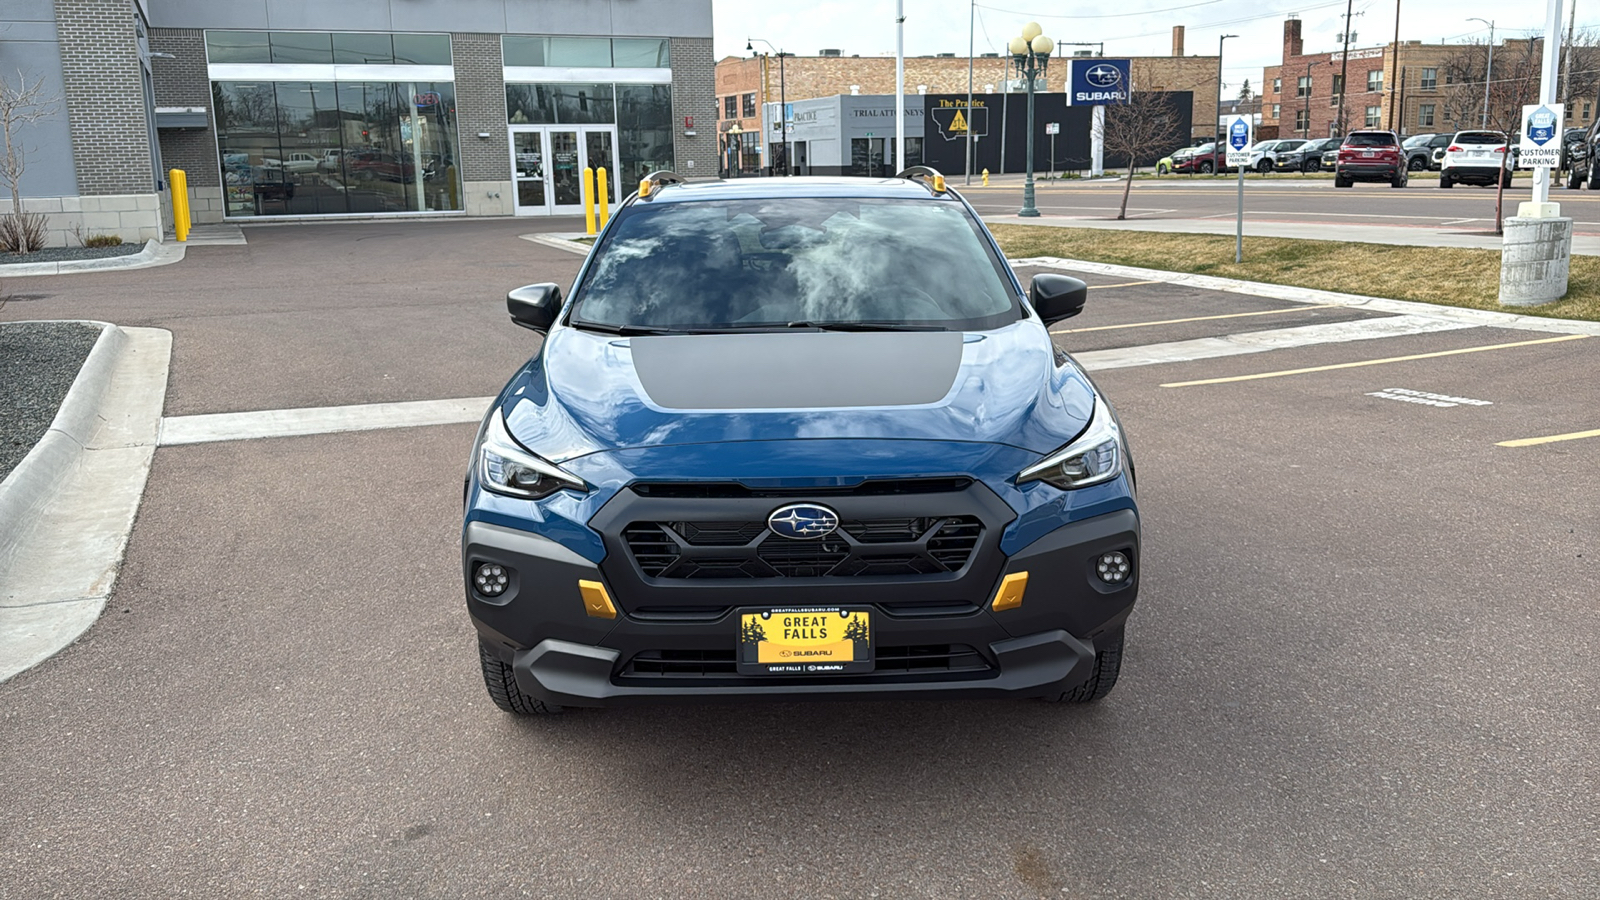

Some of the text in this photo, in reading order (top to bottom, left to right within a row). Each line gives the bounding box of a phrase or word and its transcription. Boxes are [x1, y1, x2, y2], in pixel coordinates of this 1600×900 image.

[1076, 91, 1127, 101] SUBARU
[939, 98, 985, 107] The Pratice
[794, 110, 817, 121] PRACTICE
[854, 109, 924, 117] TRIAL ATTNEYS
[1519, 149, 1561, 157] CUSTOMER
[1522, 157, 1556, 165] PARKING
[783, 617, 828, 628] GREAT
[784, 628, 828, 640] FALLS
